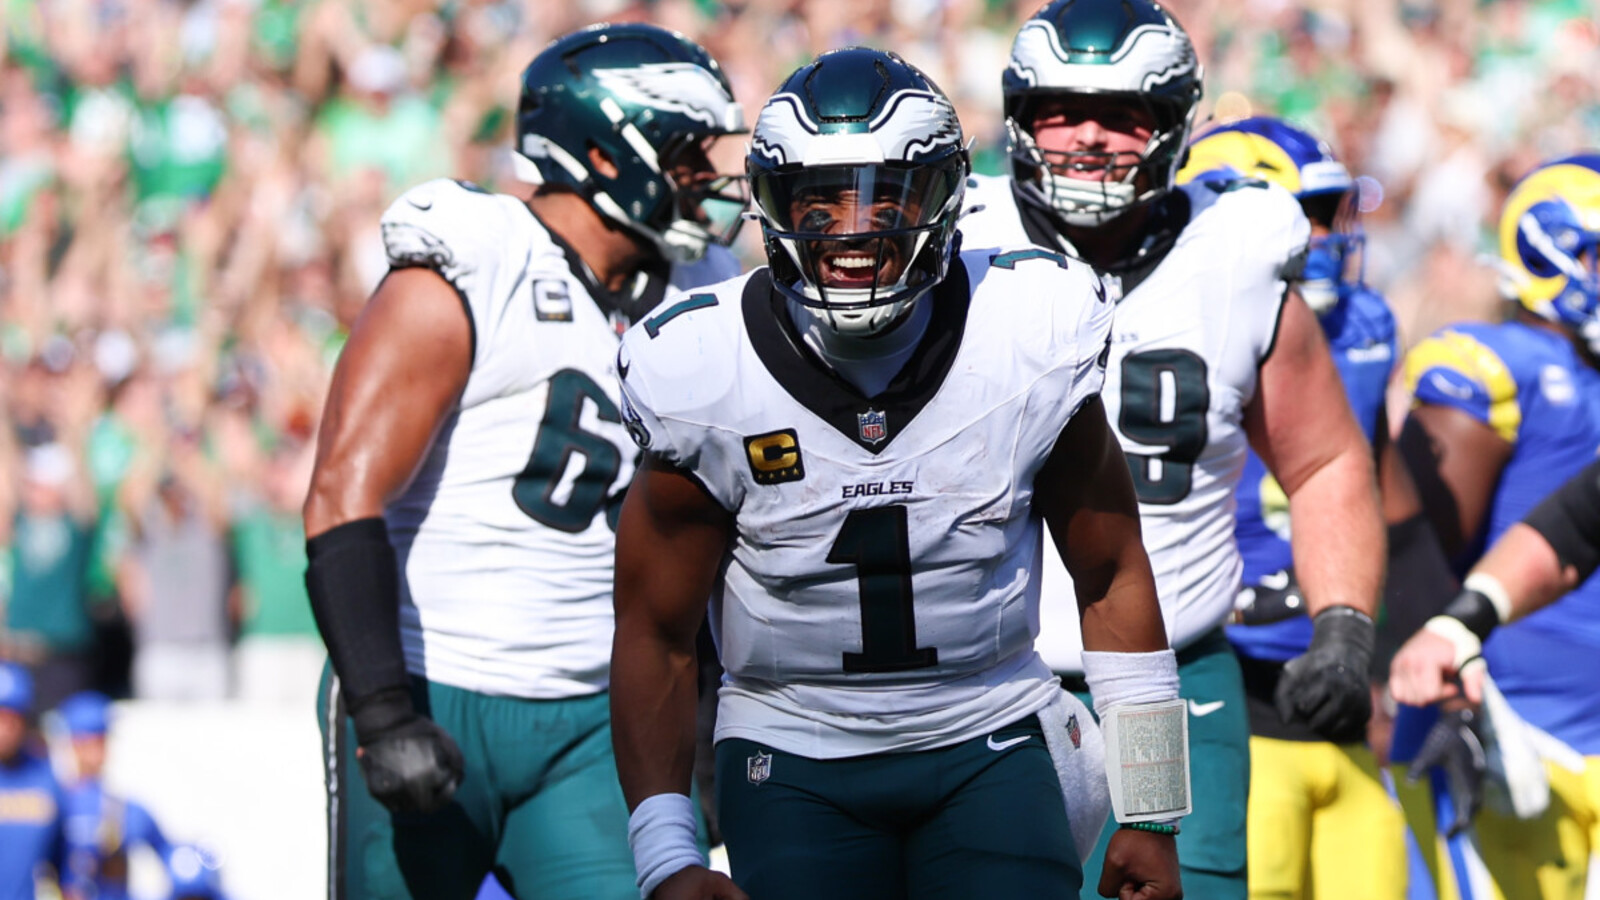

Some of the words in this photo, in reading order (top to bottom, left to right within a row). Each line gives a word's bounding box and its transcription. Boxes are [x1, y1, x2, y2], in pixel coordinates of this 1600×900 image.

[643, 293, 719, 340] 1
[511, 366, 644, 534] 6
[749, 433, 798, 471] C
[862, 425, 885, 439] NFL
[842, 481, 914, 498] EAGLES
[825, 505, 938, 674] 1
